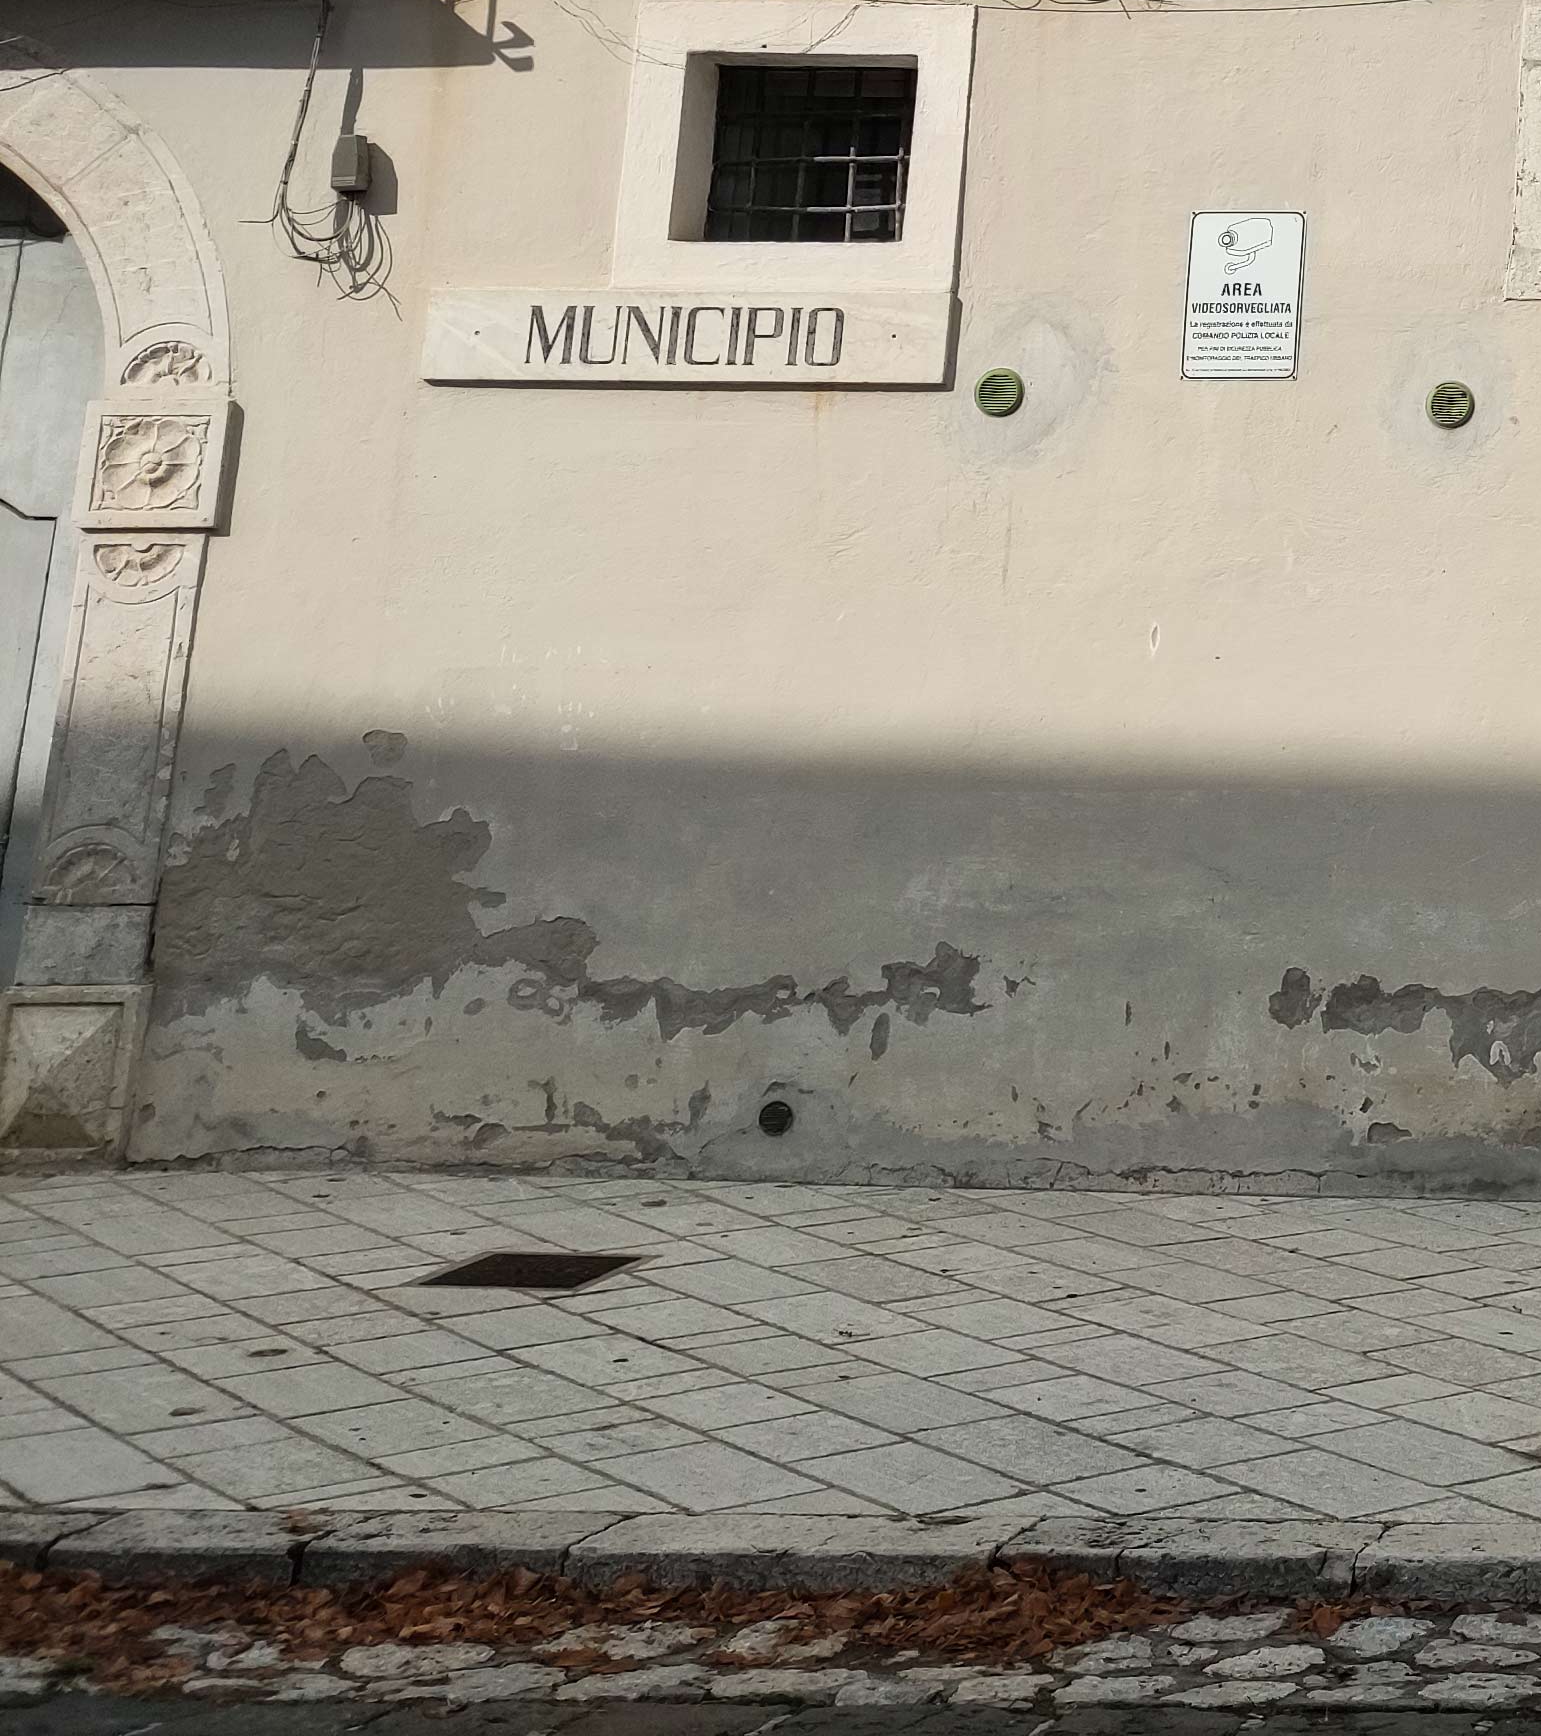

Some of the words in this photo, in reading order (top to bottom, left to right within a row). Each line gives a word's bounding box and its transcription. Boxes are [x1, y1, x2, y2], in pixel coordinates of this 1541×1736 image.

[1221, 282, 1262, 297] AREA
[1191, 302, 1292, 314] VIDEOSORVEGLIATA
[525, 305, 845, 367] MUNICIPIO
[1192, 332, 1230, 340] COMANDO
[1260, 332, 1290, 340] LOCALE
